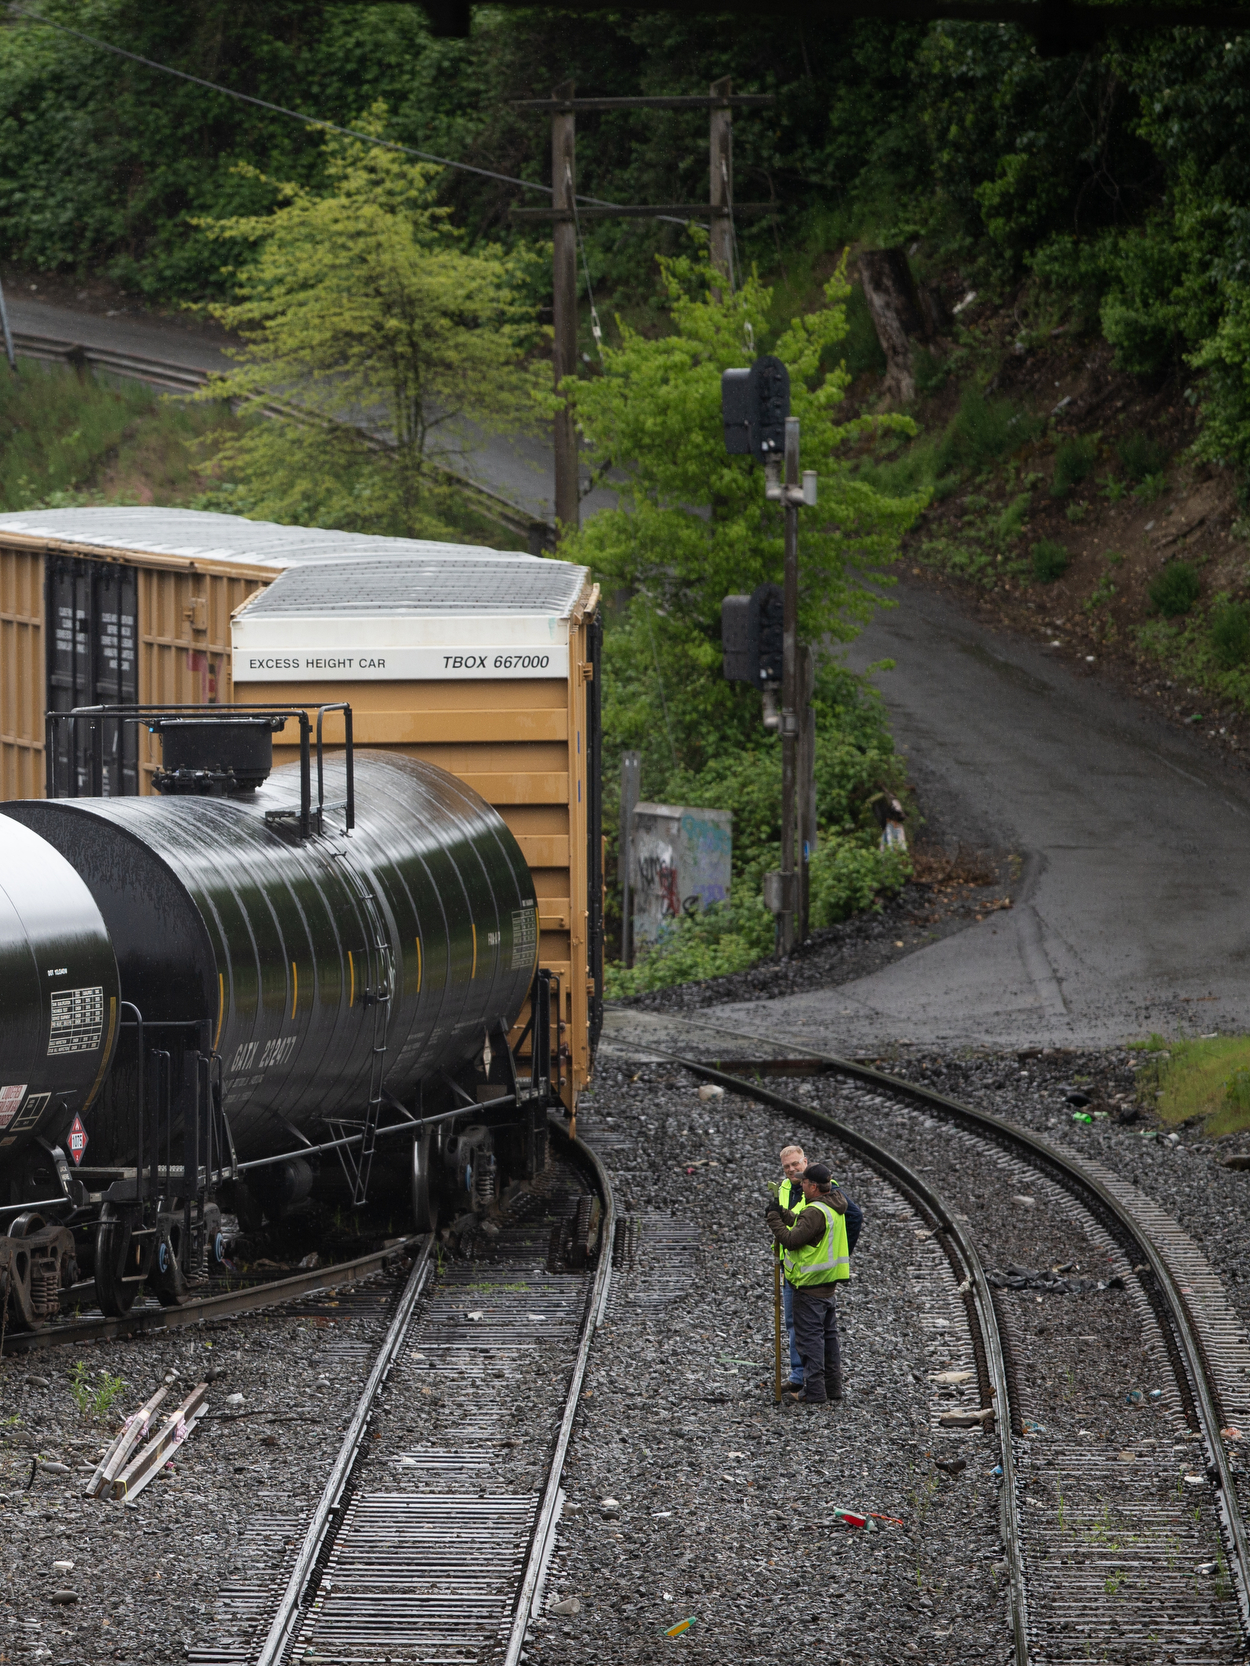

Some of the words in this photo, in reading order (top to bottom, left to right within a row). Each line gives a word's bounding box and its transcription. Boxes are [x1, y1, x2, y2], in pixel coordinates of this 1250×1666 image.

[250, 658, 300, 669] EXCESS
[306, 658, 354, 668] HEIGHT
[358, 658, 386, 668] CAR
[443, 656, 488, 668] TBOX
[493, 655, 549, 668] 667000
[231, 1041, 259, 1072] GATX
[258, 1036, 297, 1068] 232477
[72, 1134, 83, 1148] 1075
